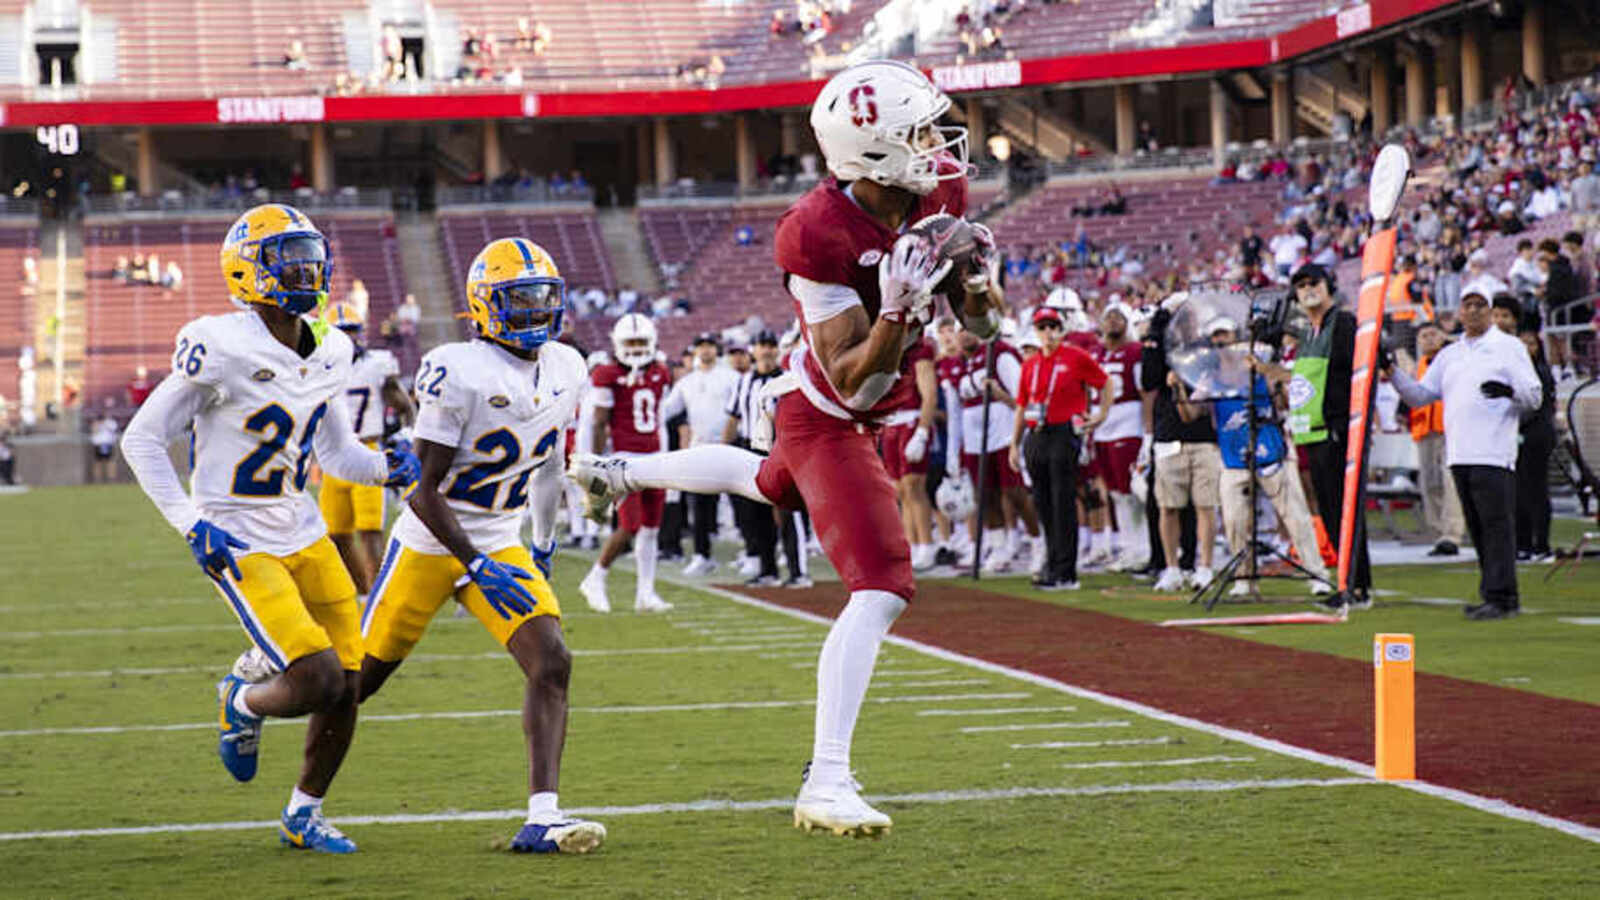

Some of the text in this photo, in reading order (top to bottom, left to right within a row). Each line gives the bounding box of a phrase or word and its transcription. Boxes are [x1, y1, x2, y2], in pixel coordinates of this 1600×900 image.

[36, 123, 79, 155] 40
[176, 337, 206, 377] 26
[417, 361, 448, 398] 22
[633, 387, 657, 434] 0
